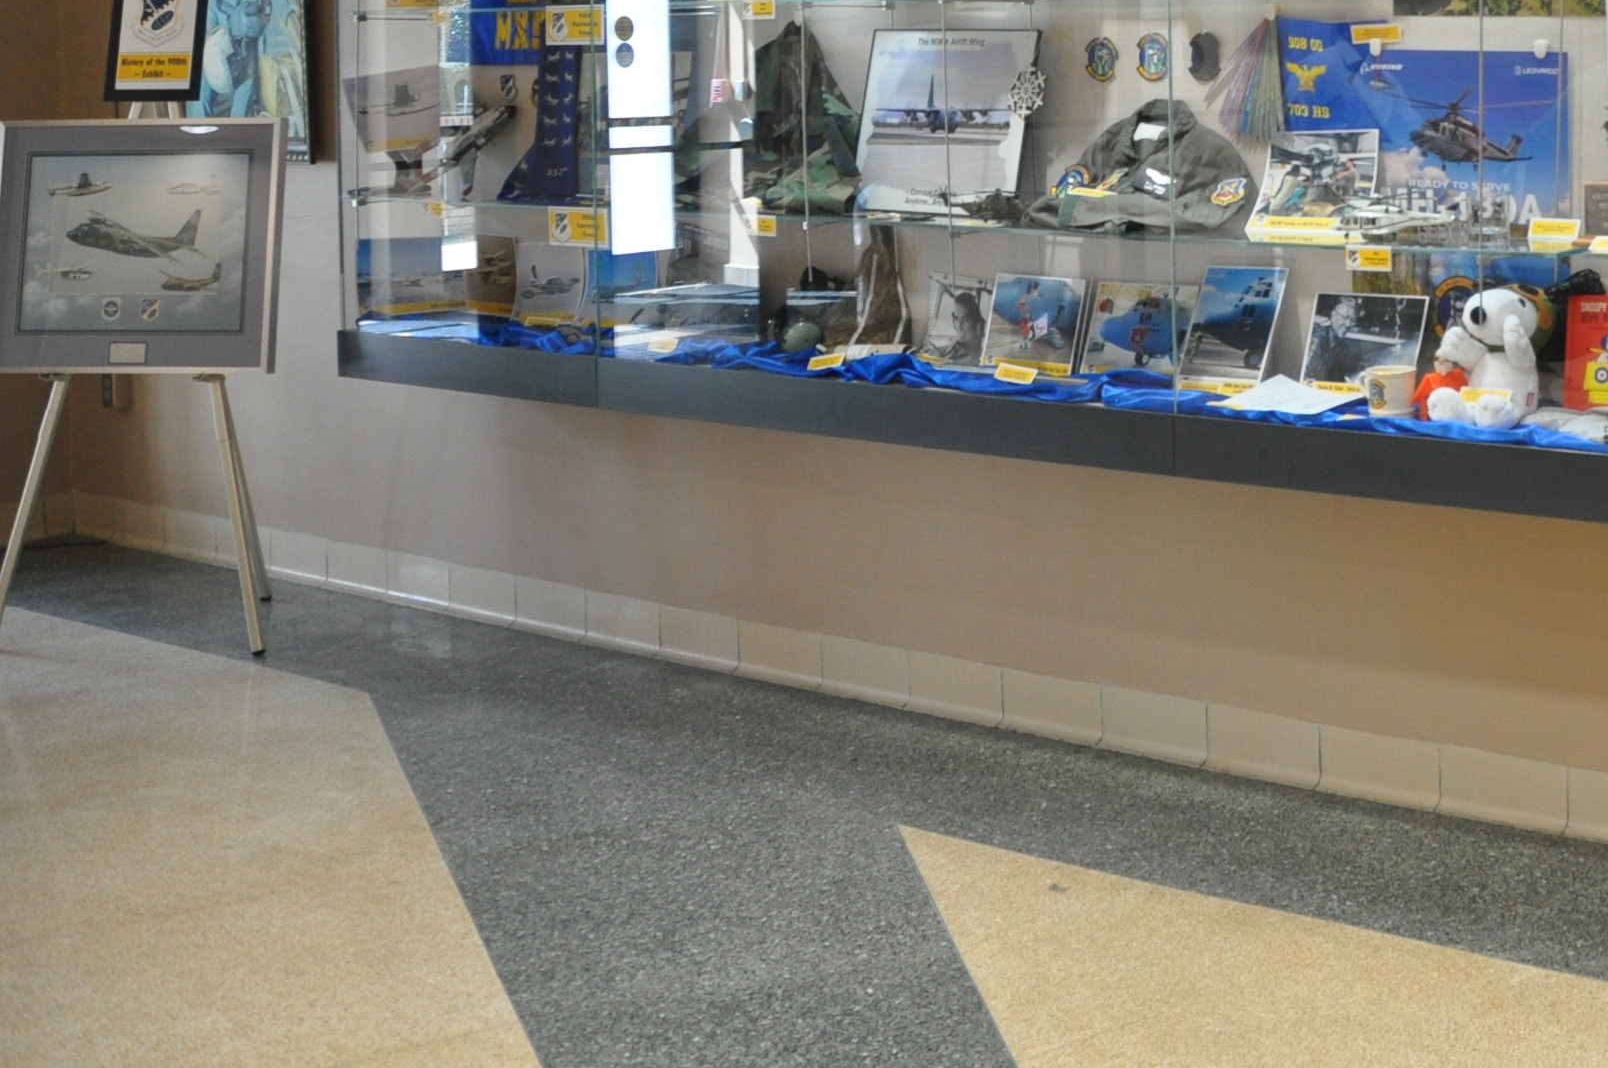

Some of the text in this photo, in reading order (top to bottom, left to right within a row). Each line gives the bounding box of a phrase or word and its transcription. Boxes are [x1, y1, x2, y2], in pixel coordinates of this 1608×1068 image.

[930, 38, 949, 46] 908h
[1408, 178, 1449, 189] READY
[1452, 180, 1469, 190] TO
